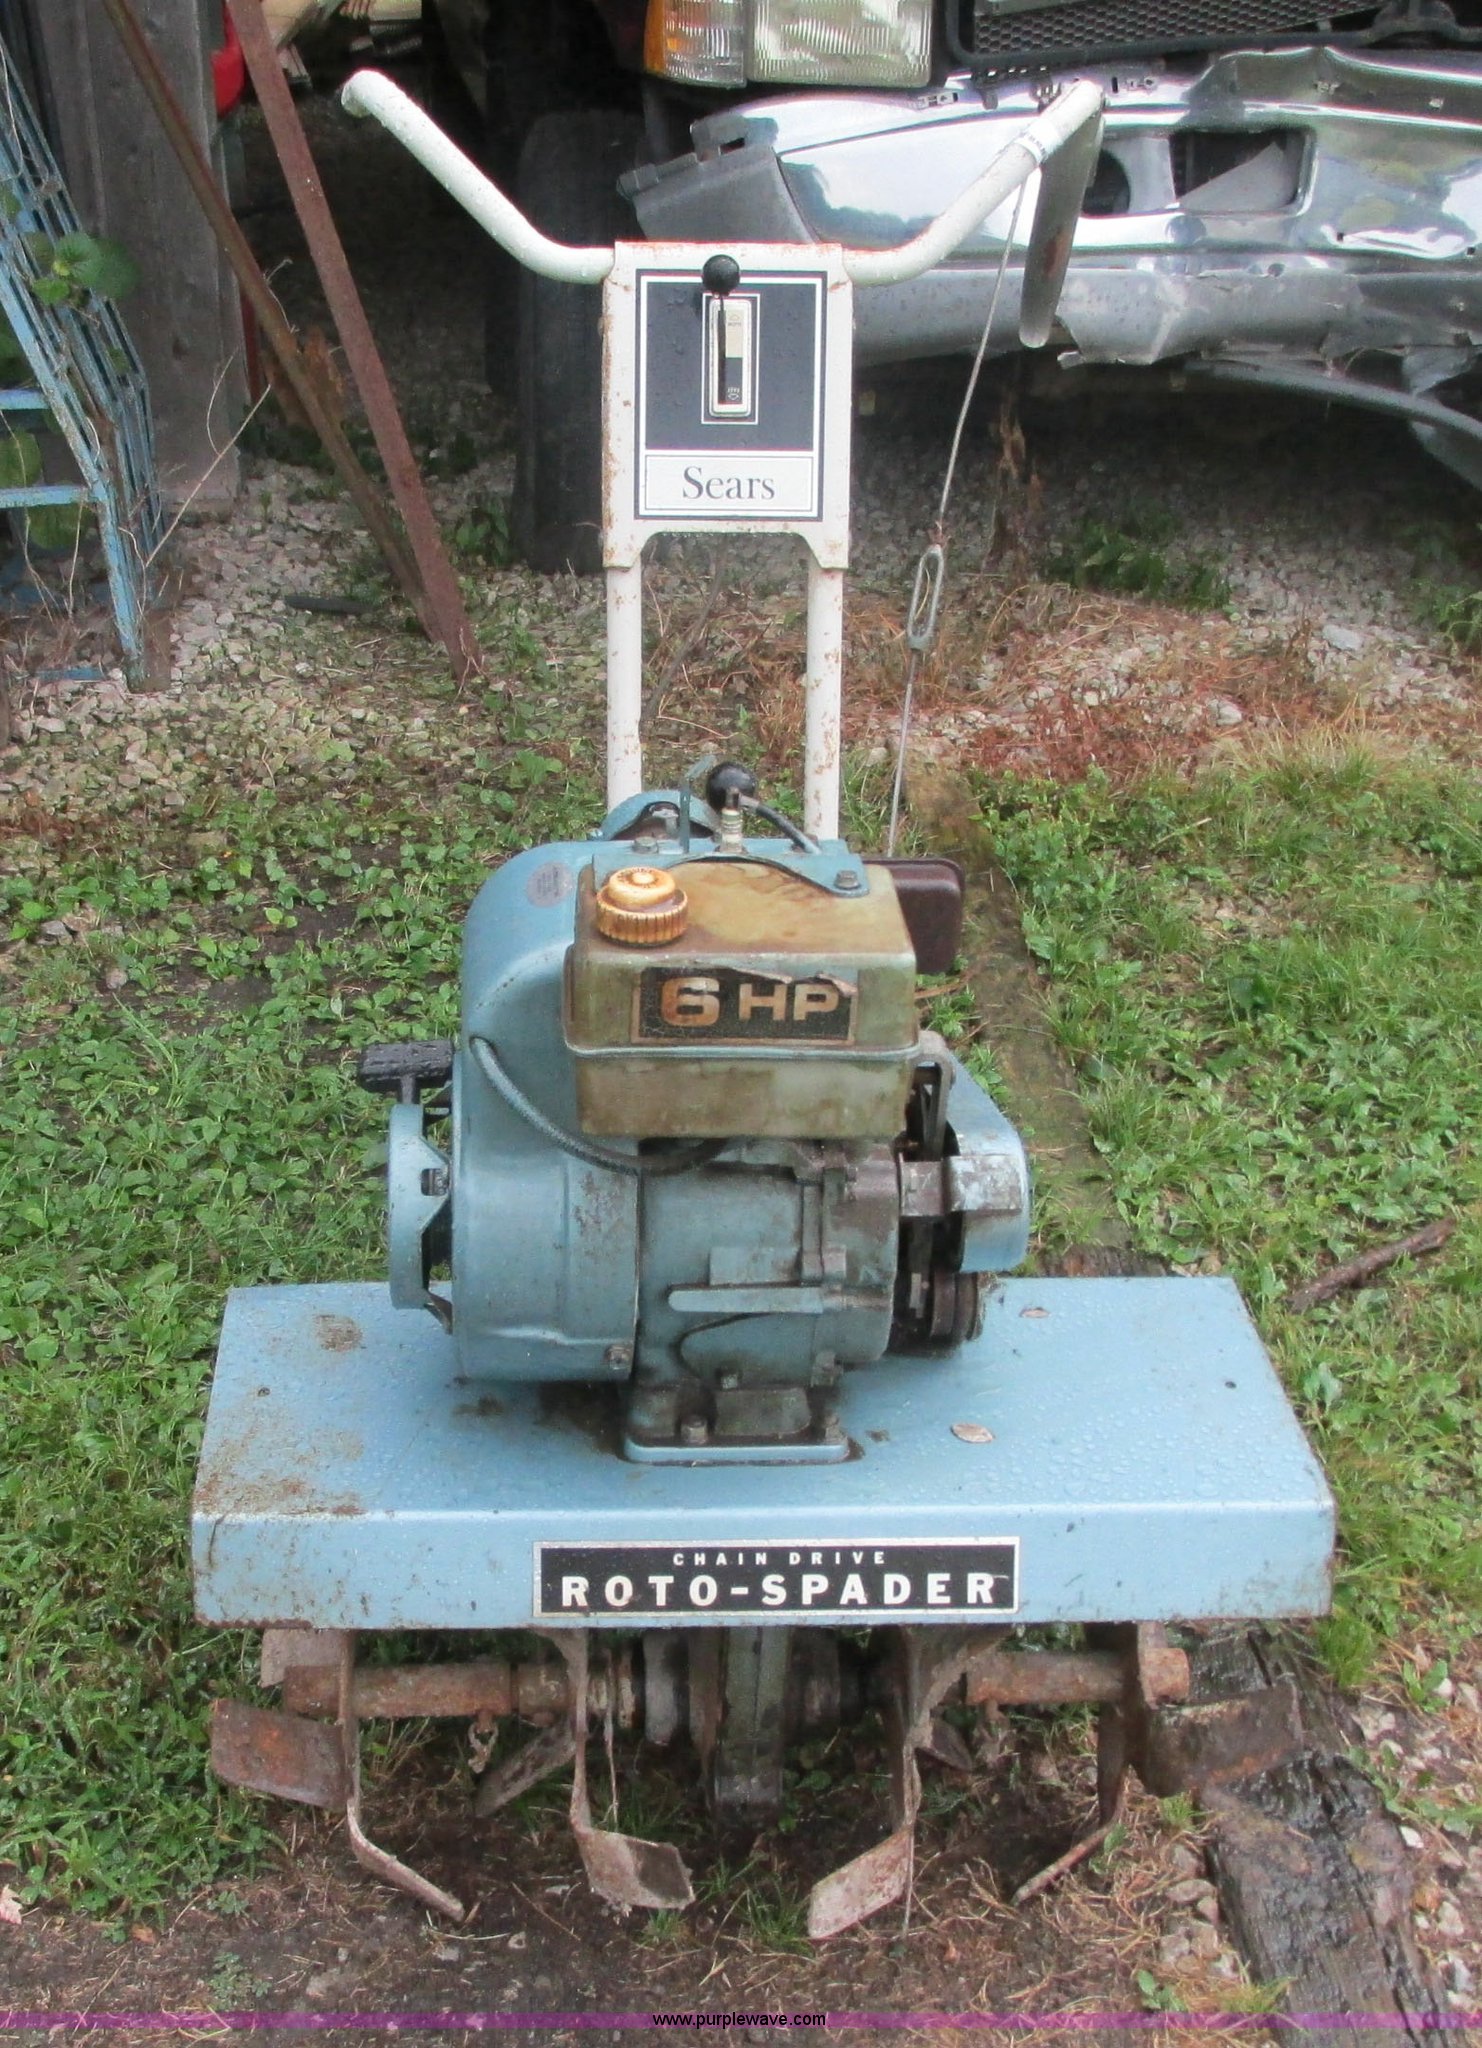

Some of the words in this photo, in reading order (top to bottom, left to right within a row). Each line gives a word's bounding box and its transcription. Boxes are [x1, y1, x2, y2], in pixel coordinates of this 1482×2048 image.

[682, 466, 775, 500] Sears
[660, 977, 720, 1027] 6
[738, 983, 839, 1021] HP
[673, 1551, 768, 1566] CHAIN
[789, 1551, 885, 1566] DRIVE
[561, 1572, 995, 1607] ROTO-SPADER
